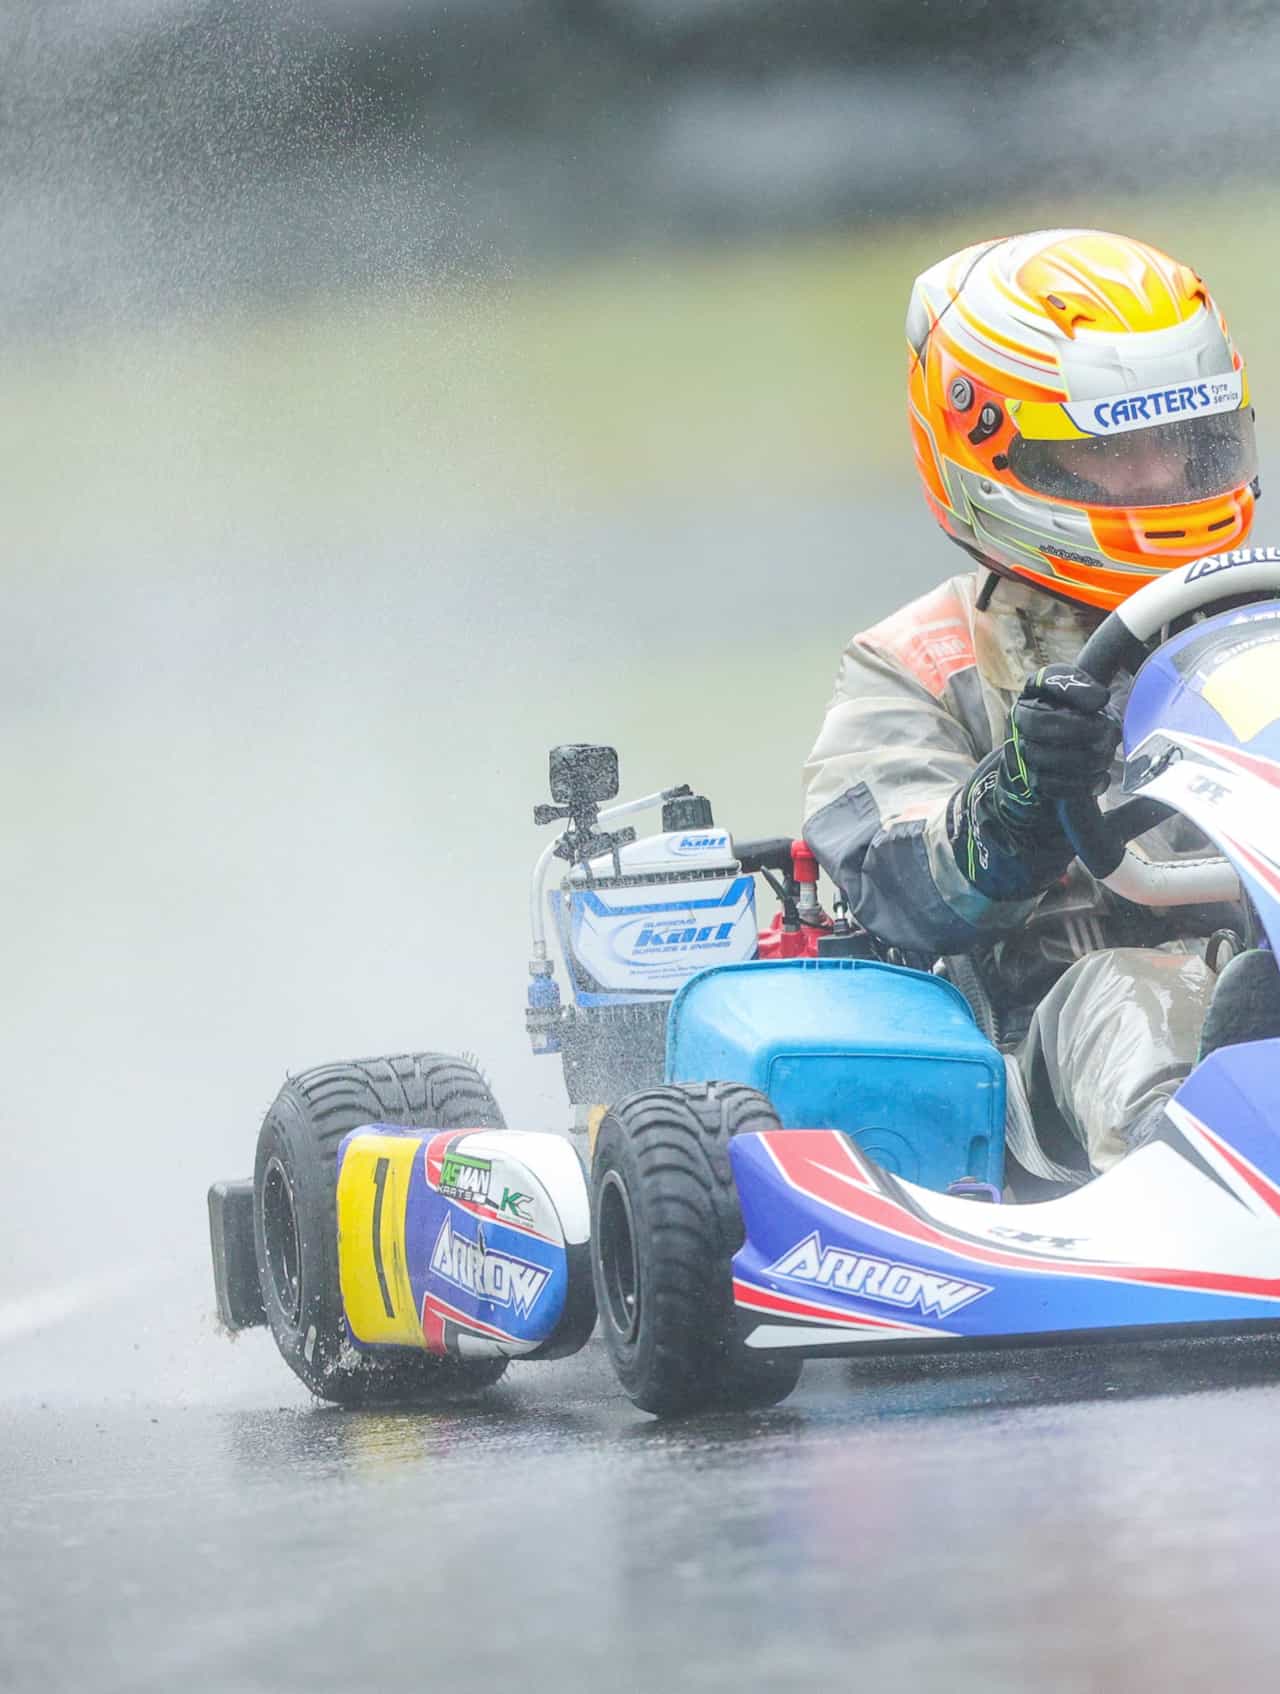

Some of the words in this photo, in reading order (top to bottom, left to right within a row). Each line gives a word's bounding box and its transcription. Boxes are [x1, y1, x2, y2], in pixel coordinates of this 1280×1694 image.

[1094, 384, 1211, 428] CARTER'S
[1211, 383, 1228, 394] tyre
[1213, 393, 1239, 404] service
[634, 922, 737, 948] kart
[373, 1158, 395, 1318] 1
[429, 1210, 553, 1320] ARROW
[761, 1231, 996, 1319] ARROW
